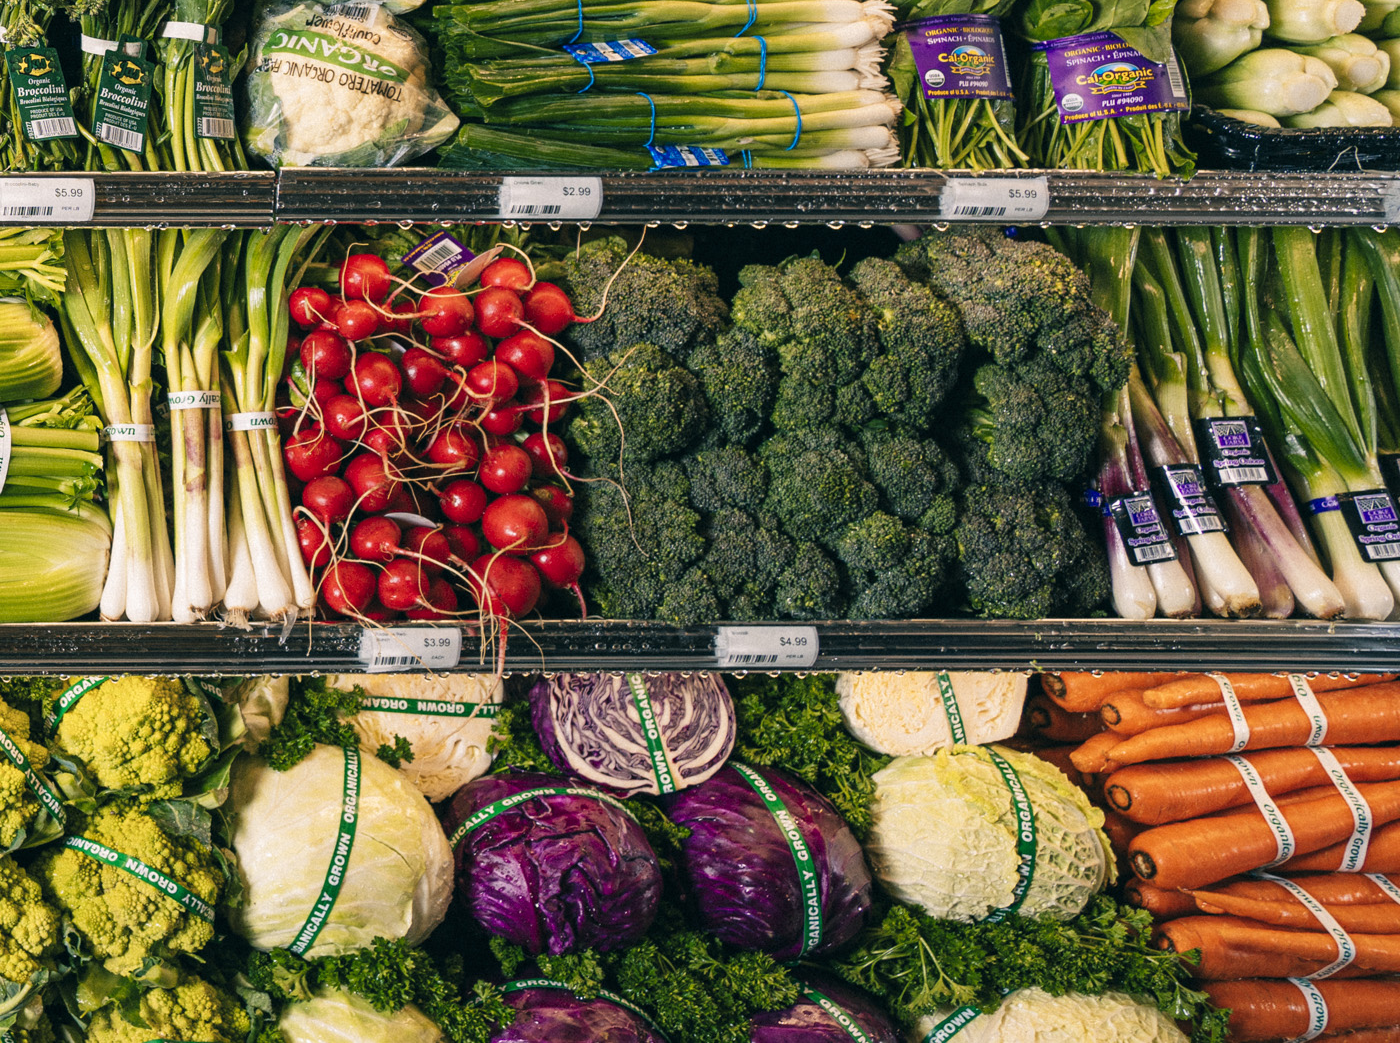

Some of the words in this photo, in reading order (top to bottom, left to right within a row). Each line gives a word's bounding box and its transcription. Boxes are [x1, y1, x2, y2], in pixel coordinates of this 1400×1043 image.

[306, 14, 381, 45] cauliflower
[925, 28, 959, 36] ORGANIC
[272, 33, 397, 76] ORGANIC
[1064, 46, 1101, 57] ORGANIC
[283, 60, 335, 81] ORGANIC
[17, 85, 64, 97] Broccolini
[115, 84, 136, 94] Organic
[196, 82, 230, 94] Broccolini
[339, 73, 402, 102] TOMATERO
[100, 88, 147, 109] Broccolini
[1117, 96, 1144, 106] #94090
[55, 188, 83, 197] $5.99
[563, 187, 591, 196] $2.99
[1008, 189, 1037, 198] $5.99
[424, 638, 450, 647] $3.99
[780, 637, 807, 646] $4.99
[417, 701, 464, 714] GROWN
[502, 788, 556, 807] GROWN
[994, 756, 1032, 842] ORGANICALLY
[1332, 769, 1368, 835] Organically
[329, 833, 350, 886] GROWN
[344, 746, 359, 823] ORGANICALLY
[777, 810, 808, 861] GROWN
[1349, 836, 1364, 870] Grown
[126, 859, 178, 894] GROWN
[1310, 992, 1325, 1032] Grown
